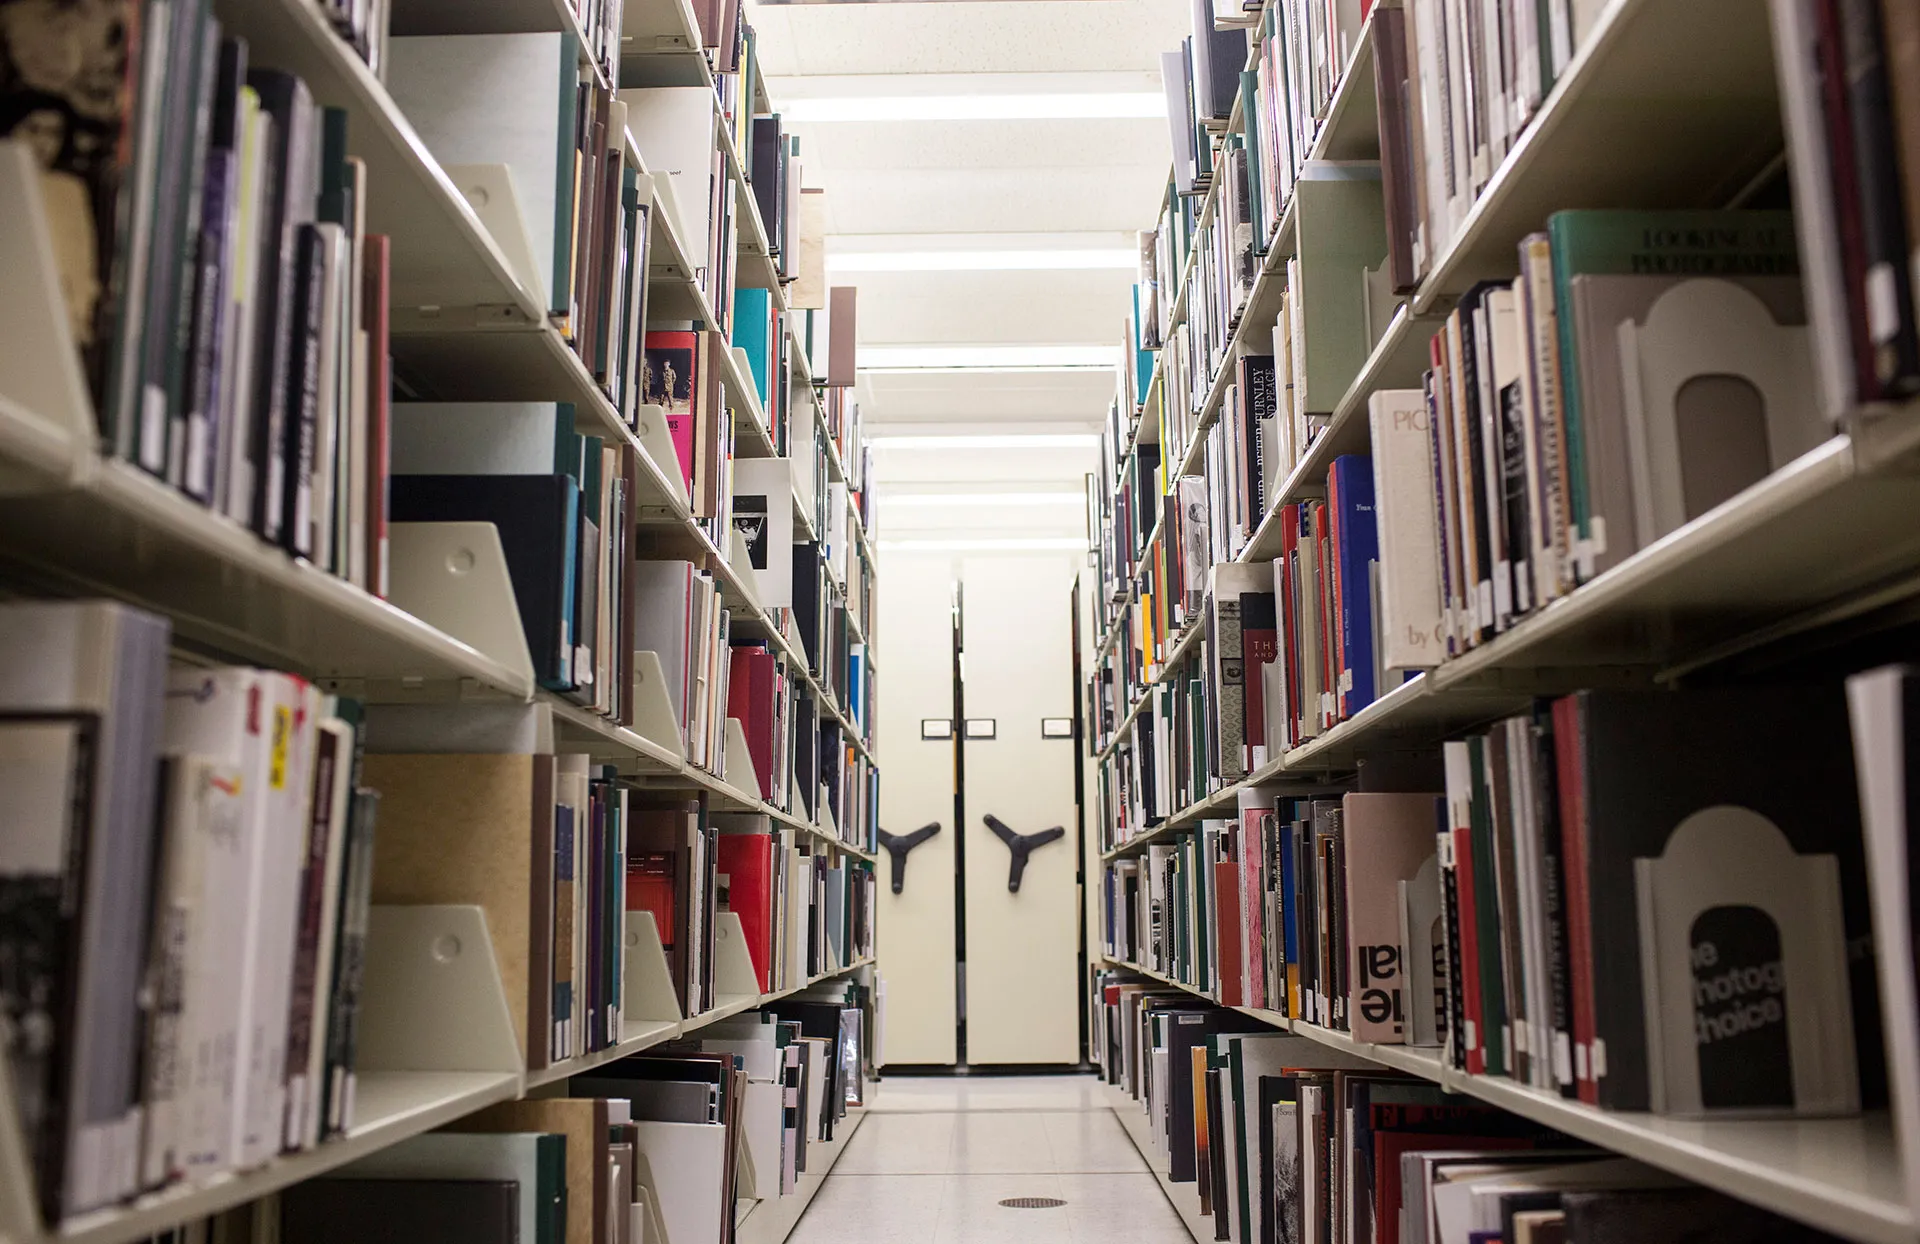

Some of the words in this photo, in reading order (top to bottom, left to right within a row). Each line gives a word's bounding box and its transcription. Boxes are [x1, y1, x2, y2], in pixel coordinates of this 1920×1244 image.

[1254, 368, 1265, 423] TURNLEY
[1265, 368, 1276, 402] PEACE
[1408, 624, 1430, 649] by
[1696, 997, 1783, 1045] hoice
